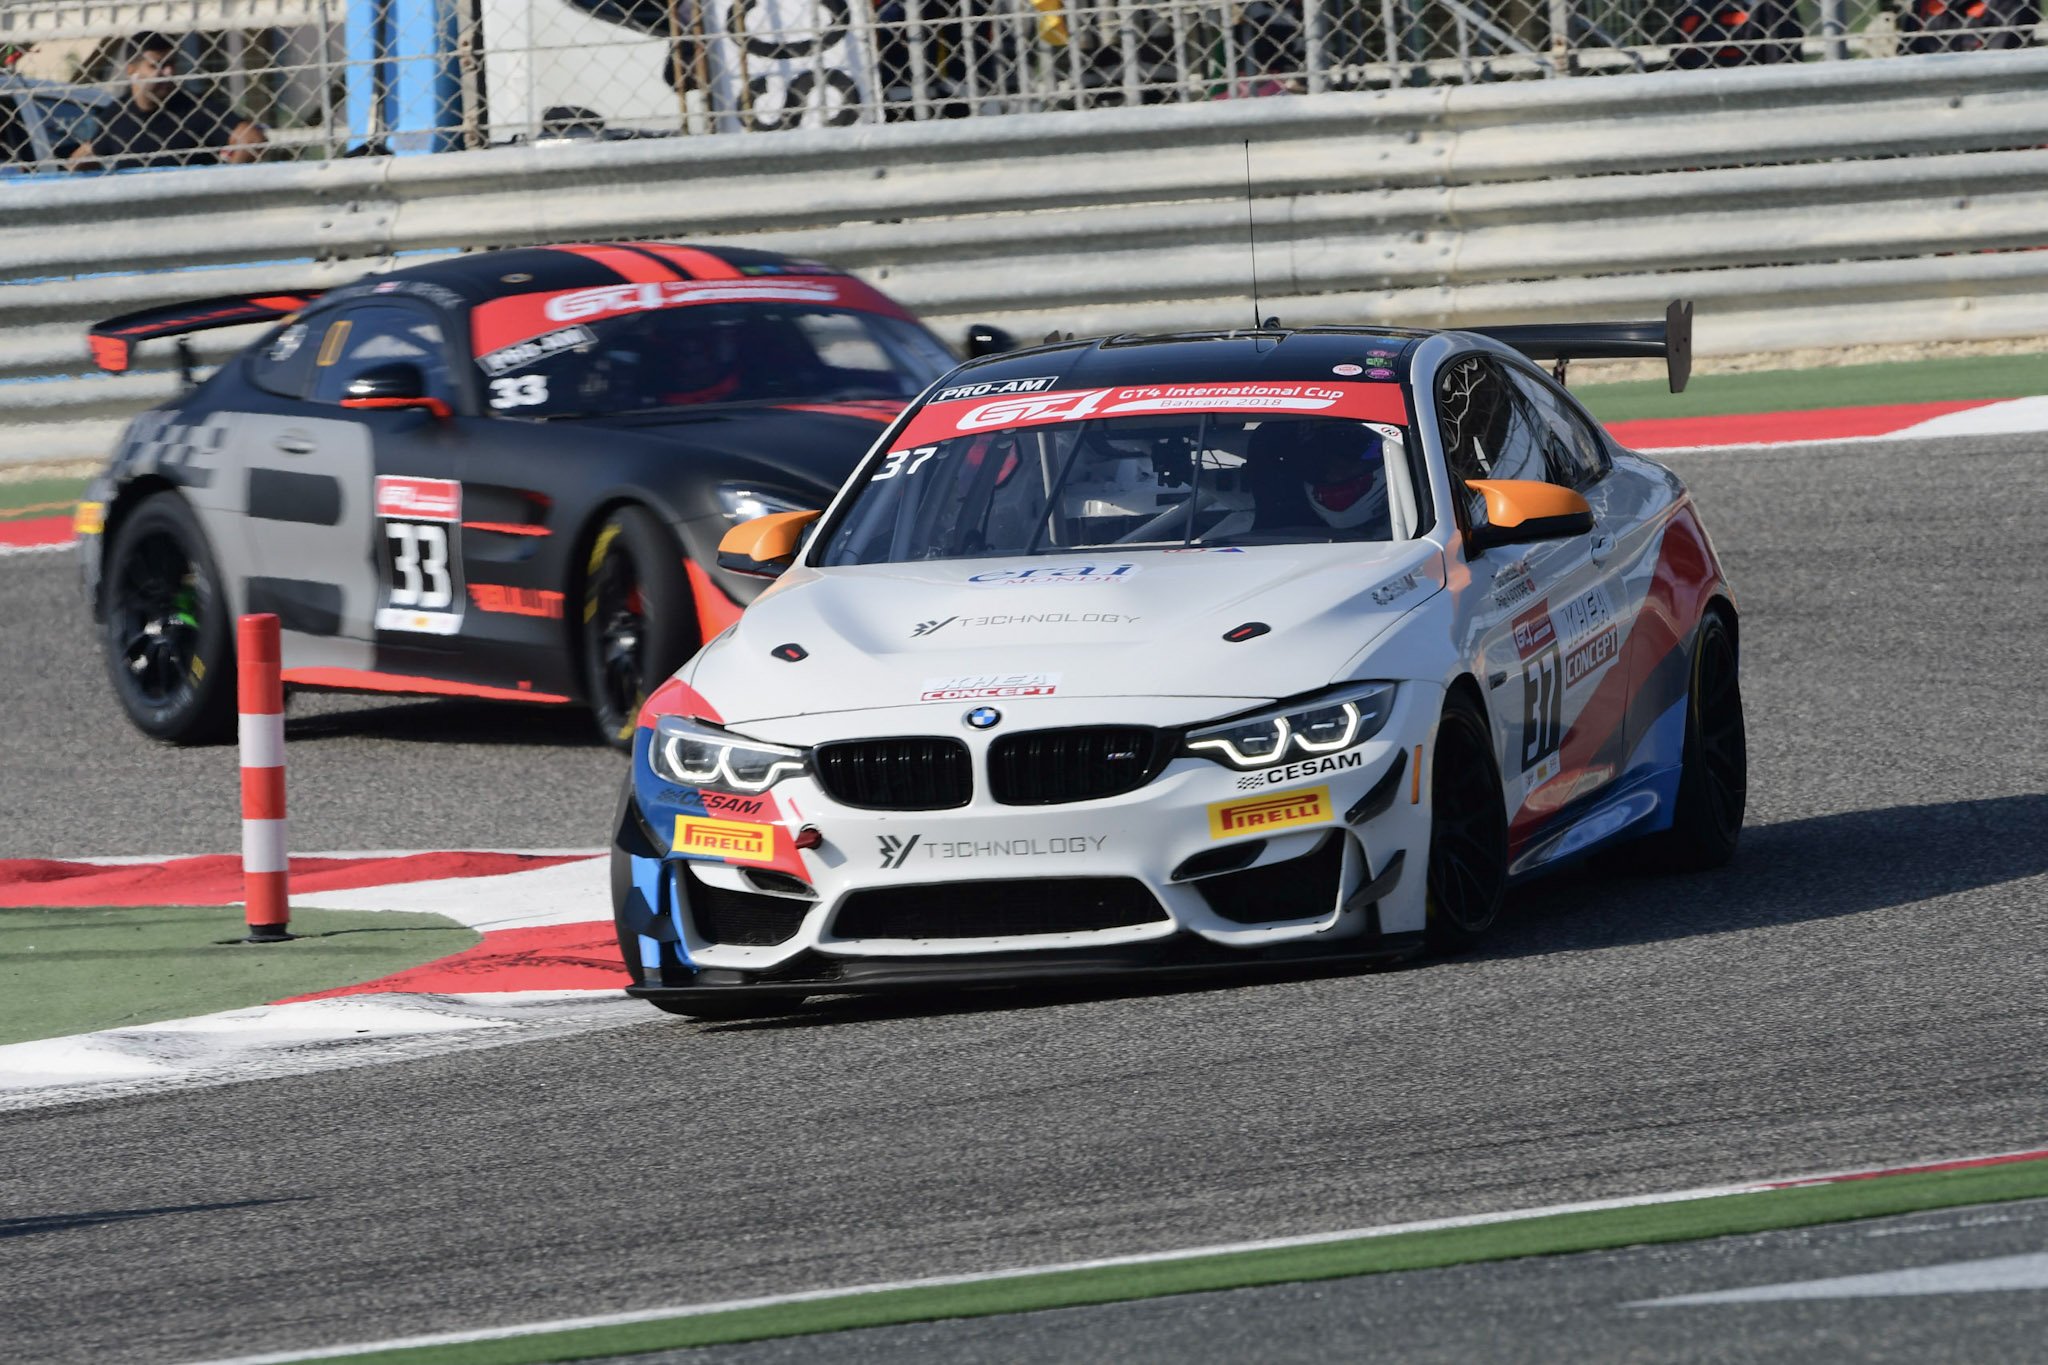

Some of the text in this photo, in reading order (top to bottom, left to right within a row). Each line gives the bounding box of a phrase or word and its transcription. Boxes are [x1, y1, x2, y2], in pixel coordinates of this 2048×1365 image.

[489, 375, 549, 409] 33
[938, 379, 1047, 401] PRO-AM
[1119, 385, 1344, 399] GT4 International Cup
[1160, 398, 1282, 407] Bahrain 2018
[955, 387, 1115, 430] GT4
[871, 446, 938, 482] 37
[386, 523, 452, 608] 33
[1566, 627, 1617, 684] CONCEPT
[922, 685, 1055, 700] CONCEPT
[1527, 651, 1556, 761] 37
[1267, 752, 1362, 784] CESAM
[680, 790, 763, 814] CESAM
[1220, 793, 1320, 830] PIRELLI
[684, 823, 763, 853] PIRELLI
